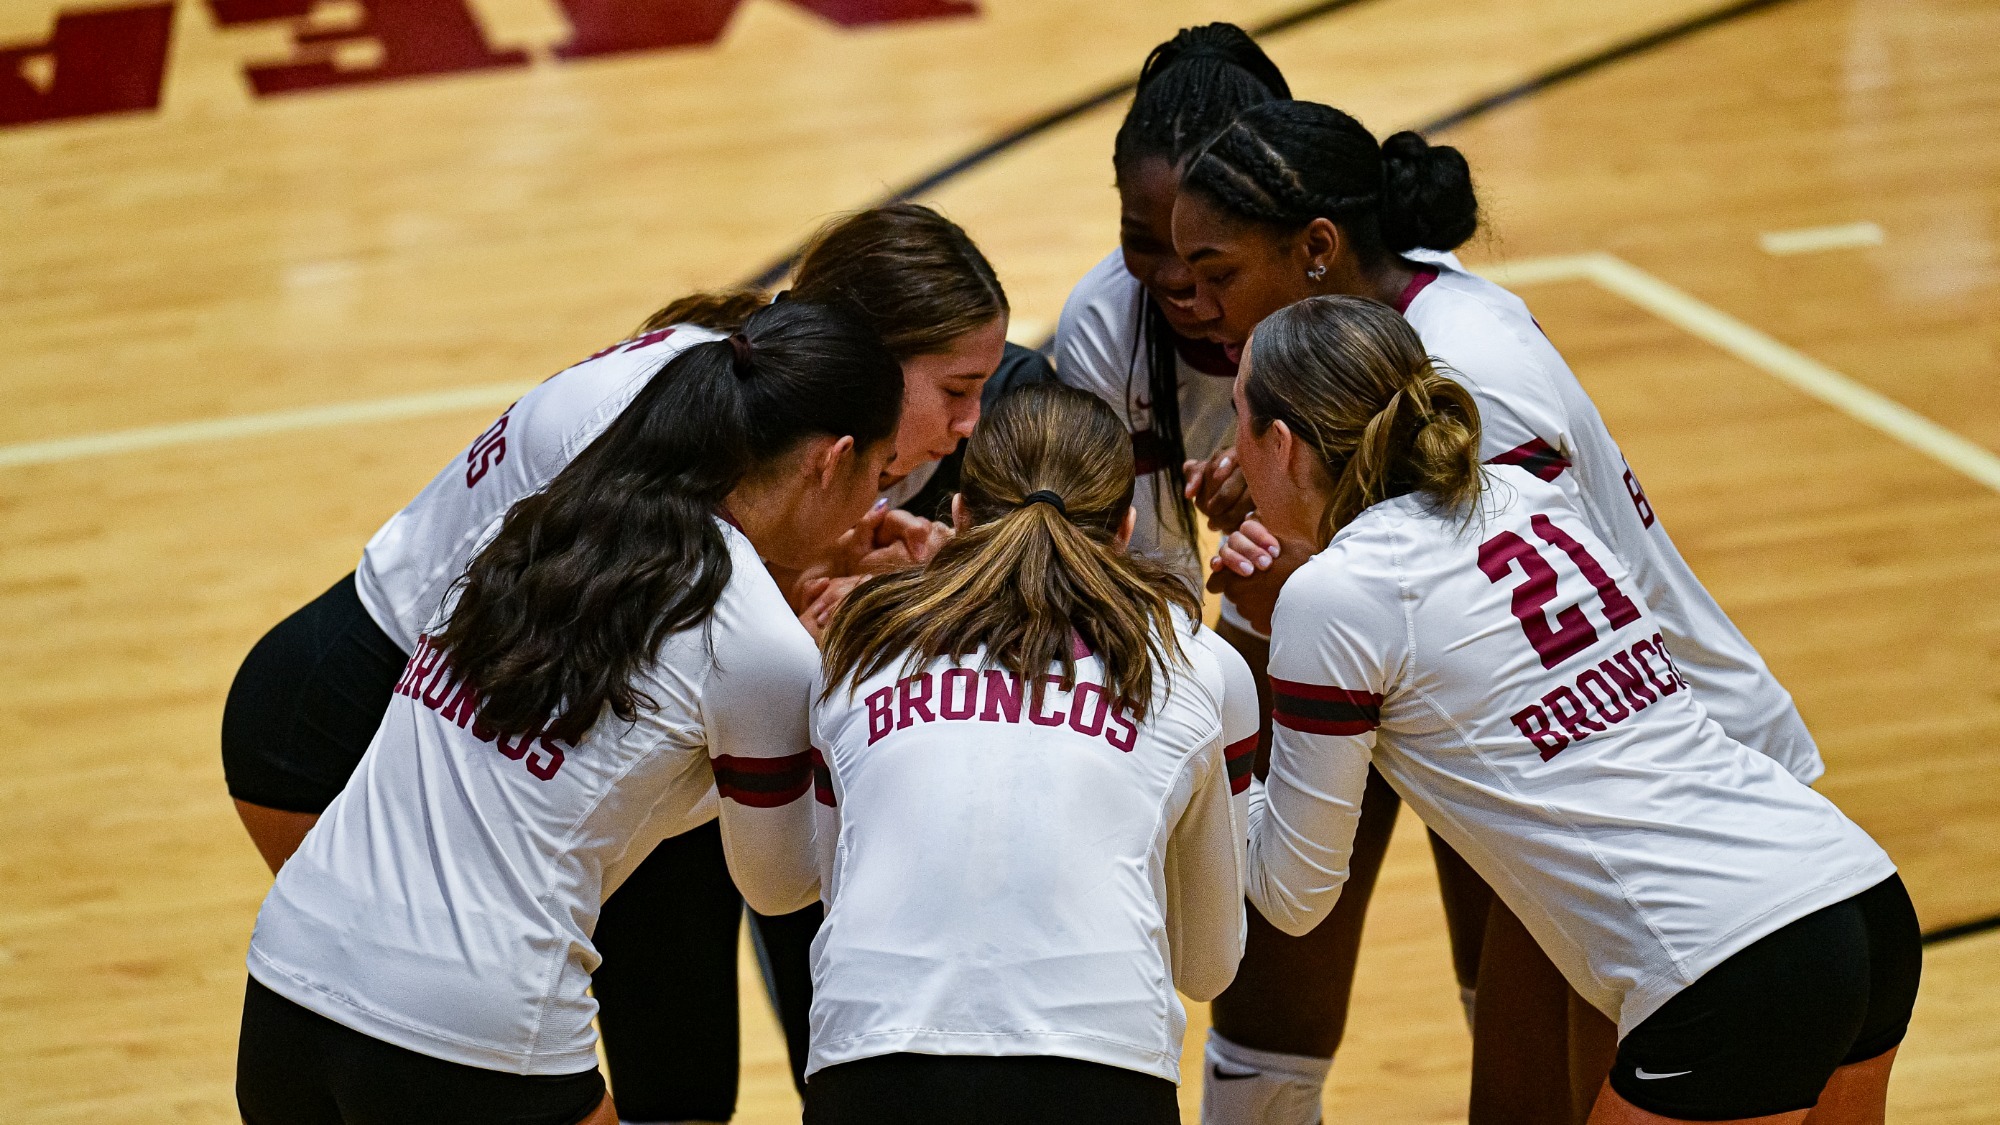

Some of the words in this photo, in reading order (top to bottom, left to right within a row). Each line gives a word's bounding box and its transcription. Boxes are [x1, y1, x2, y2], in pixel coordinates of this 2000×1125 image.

[1476, 513, 1642, 671] 21
[393, 633, 579, 782] BRONOS
[864, 667, 1144, 754] BRONCOS
